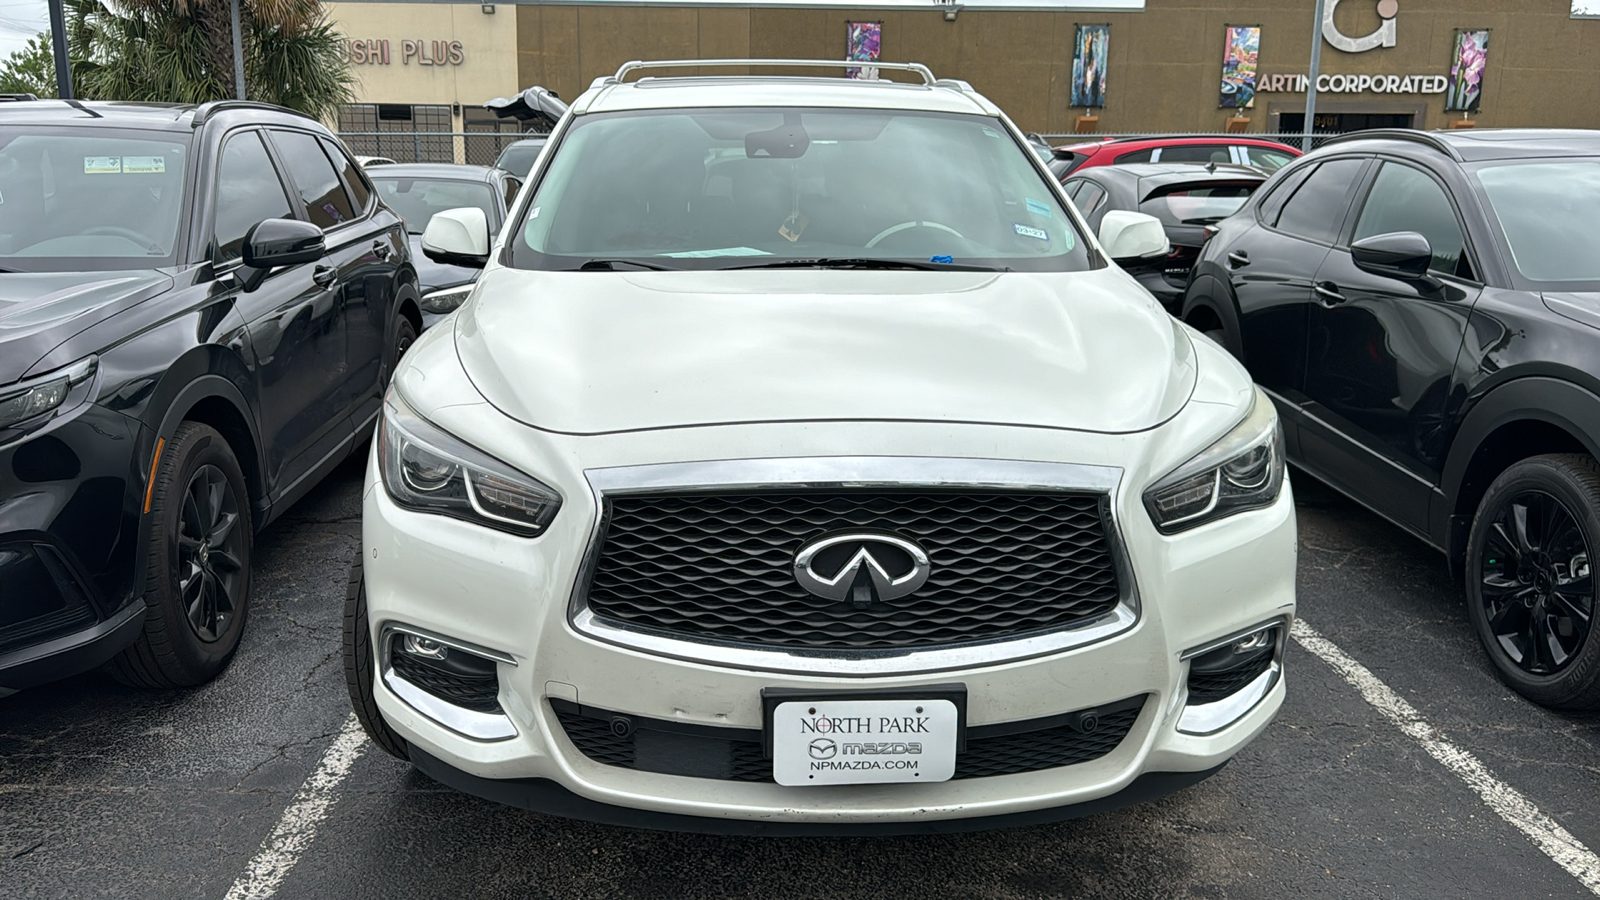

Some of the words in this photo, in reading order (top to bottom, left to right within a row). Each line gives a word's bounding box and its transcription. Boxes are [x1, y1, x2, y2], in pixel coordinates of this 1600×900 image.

[333, 39, 390, 66] USHI
[401, 39, 464, 66] PLUS
[800, 717, 871, 734] NORTH
[879, 717, 930, 734] PARK
[810, 760, 918, 771] NPMAZDA.COM
